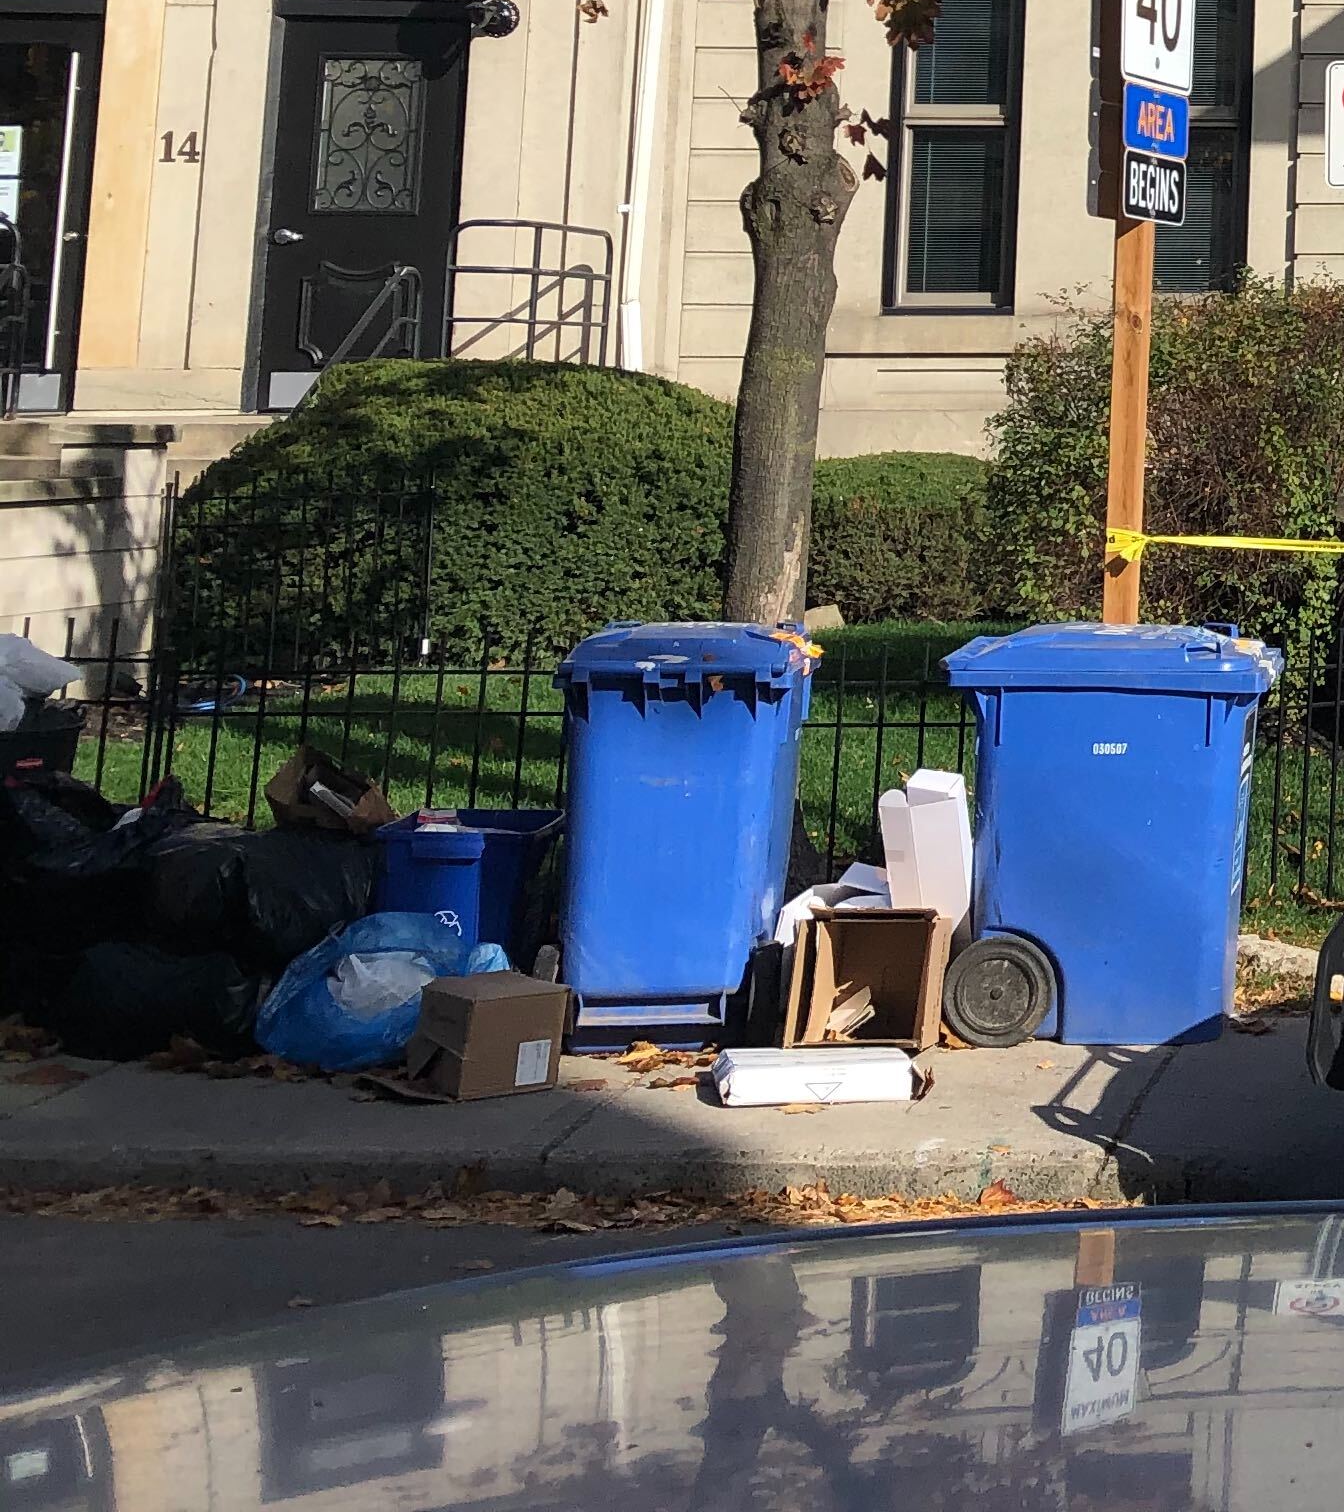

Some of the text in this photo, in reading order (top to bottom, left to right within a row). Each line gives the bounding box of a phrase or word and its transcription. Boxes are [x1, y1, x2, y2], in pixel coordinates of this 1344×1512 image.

[1137, 101, 1175, 142] AREA
[159, 131, 200, 163] 14
[1129, 161, 1179, 214] BEGINS
[1093, 743, 1128, 754] 030507
